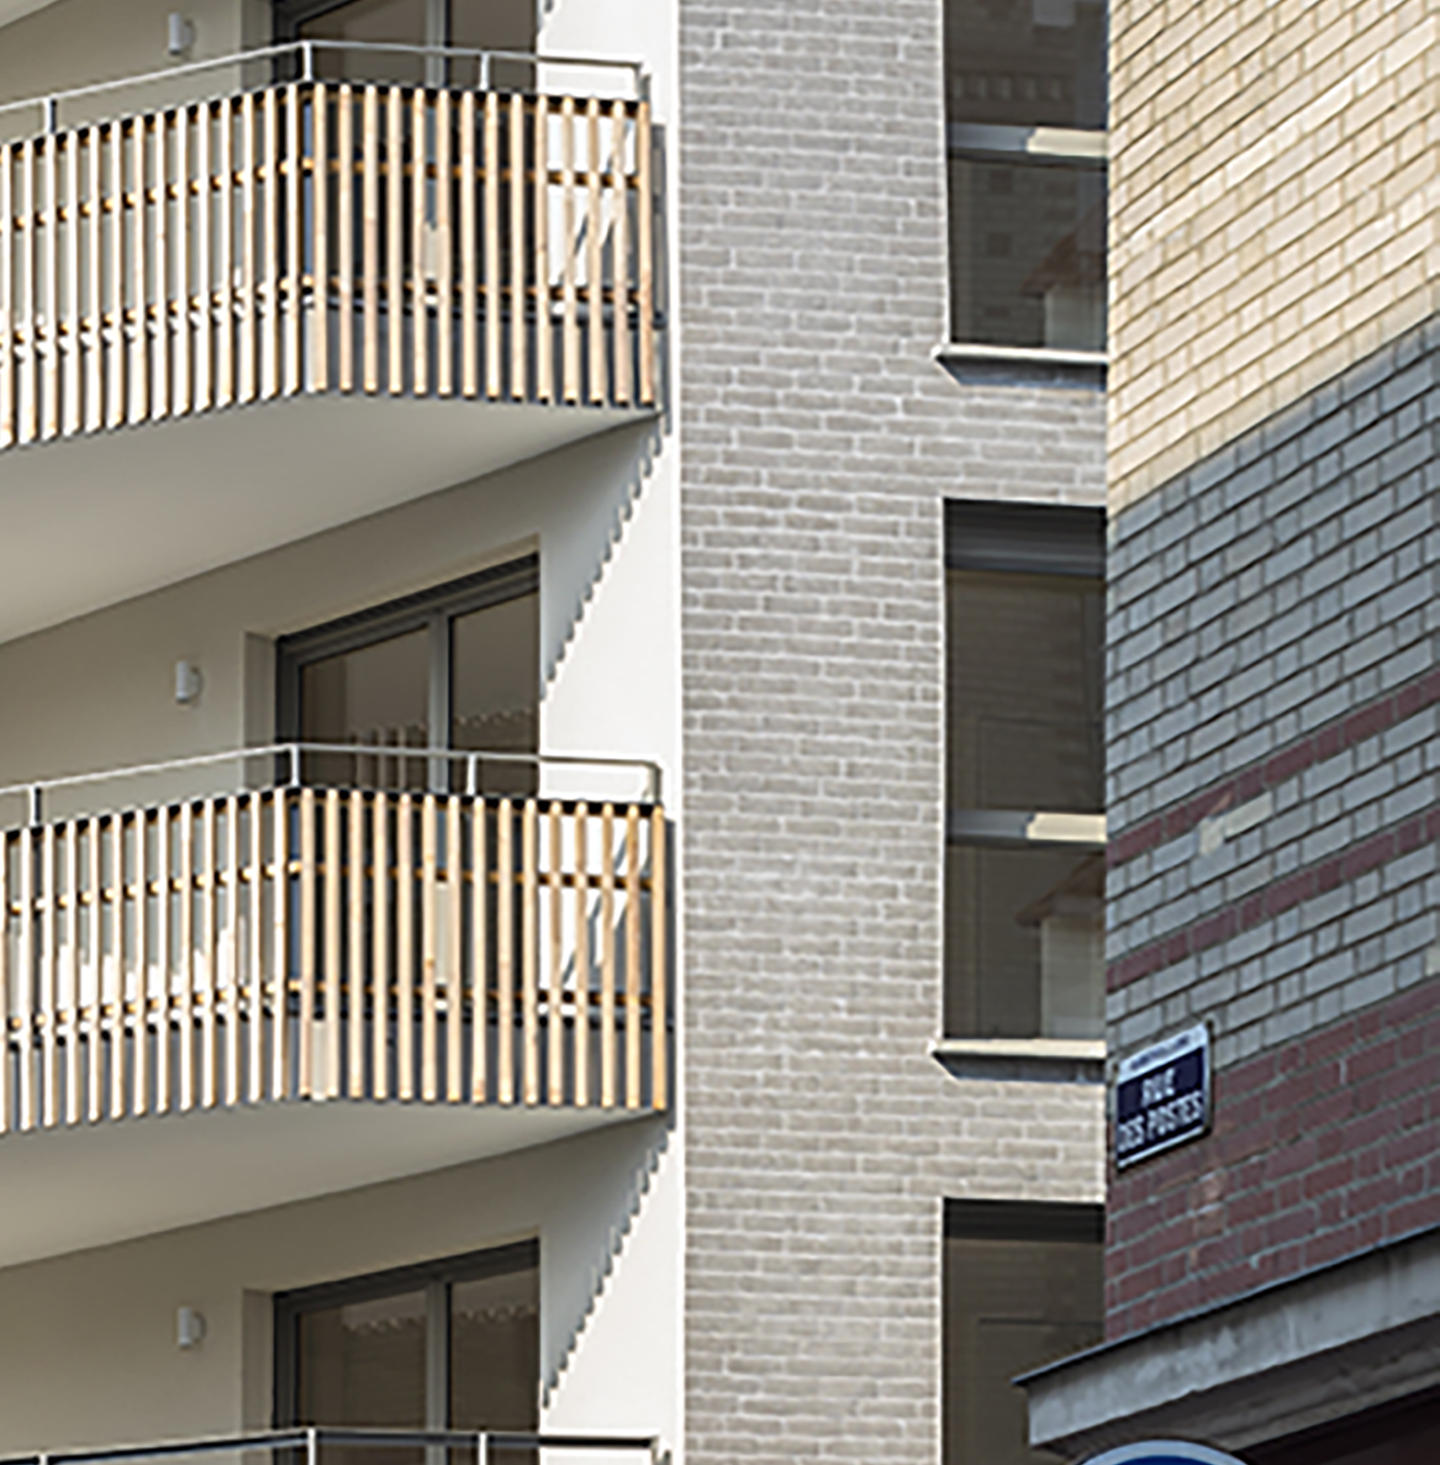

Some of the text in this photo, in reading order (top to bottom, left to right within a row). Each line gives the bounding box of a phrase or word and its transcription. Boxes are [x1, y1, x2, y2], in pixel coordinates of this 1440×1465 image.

[1141, 1067, 1175, 1108] RUE
[1118, 1091, 1202, 1152] DES POSTES
